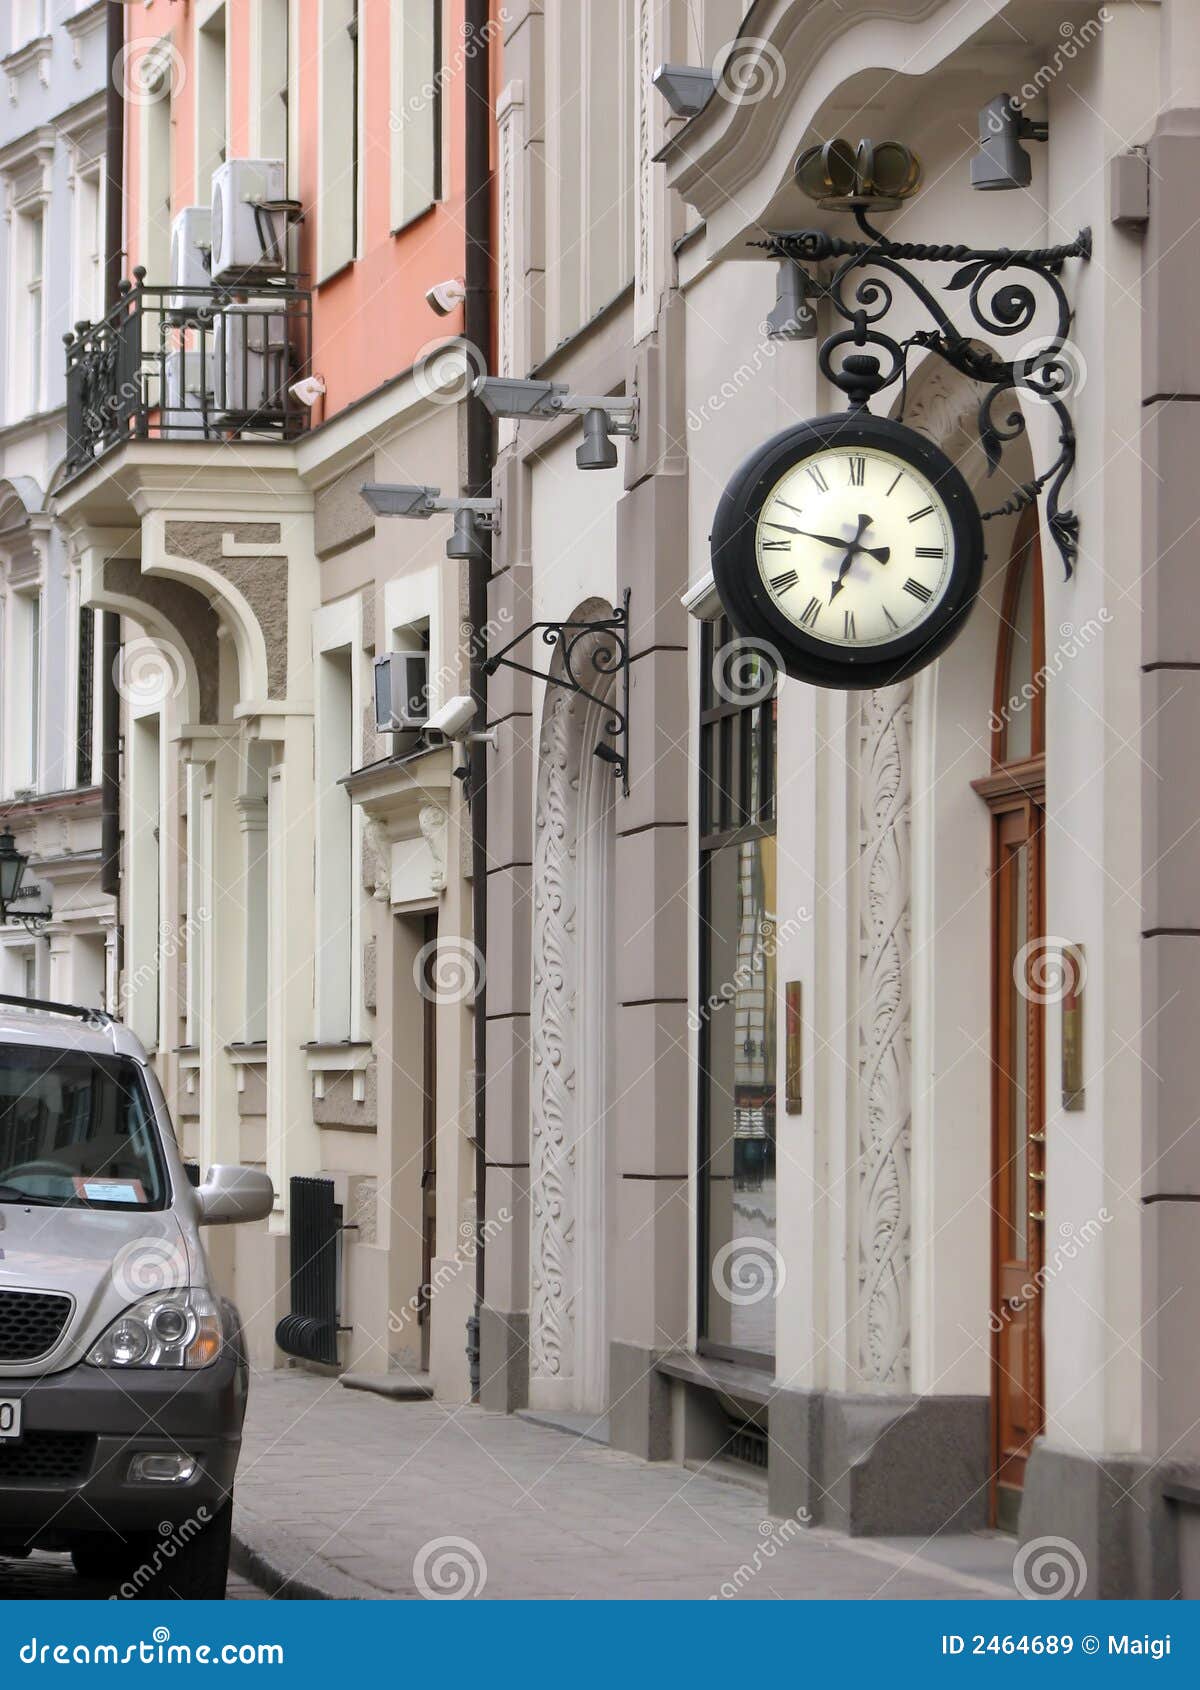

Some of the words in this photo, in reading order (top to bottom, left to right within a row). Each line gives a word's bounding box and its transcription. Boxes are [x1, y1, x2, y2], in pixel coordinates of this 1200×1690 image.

[848, 457, 866, 487] XII
[907, 505, 935, 523] II
[915, 547, 943, 559] III
[902, 577, 933, 603] IIII
